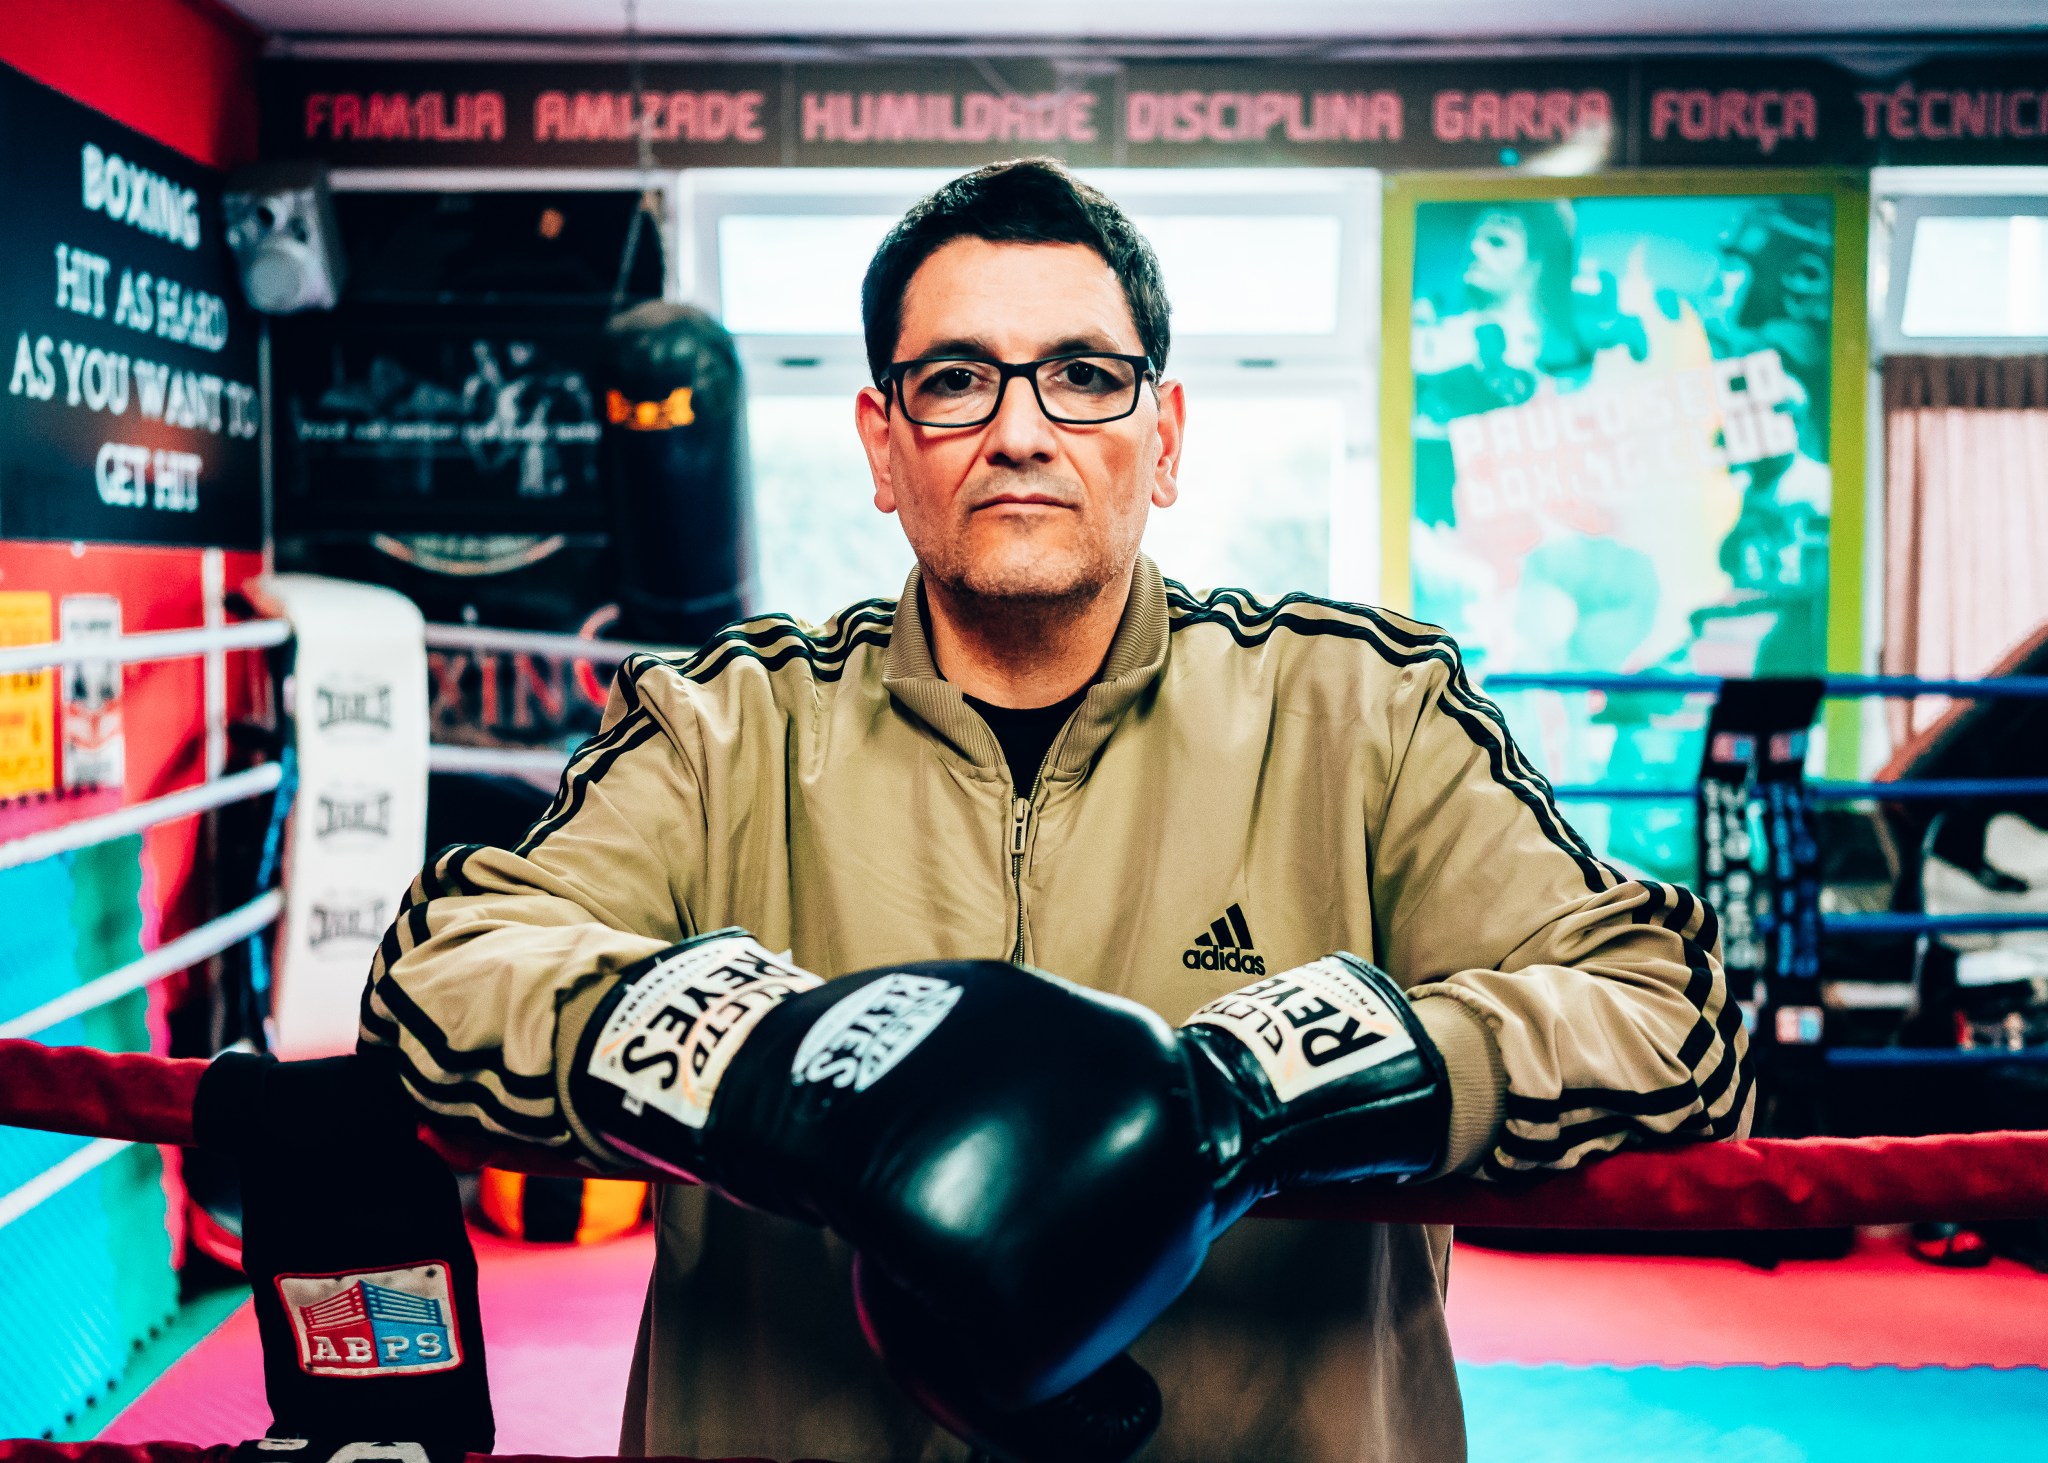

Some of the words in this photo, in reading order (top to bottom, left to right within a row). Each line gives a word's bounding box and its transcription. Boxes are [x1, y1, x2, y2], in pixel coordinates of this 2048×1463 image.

[534, 90, 765, 142] AMIZADE
[802, 91, 1097, 142] HUMILDADE
[1125, 90, 1402, 142] DISCIPLINA
[1650, 90, 1817, 155] FORÇA
[81, 141, 201, 251] BOXING
[54, 242, 111, 318] HIT
[114, 265, 154, 332] AS
[156, 277, 229, 352] HARD
[8, 330, 55, 401] AS
[59, 340, 130, 416] YOU
[133, 357, 223, 435] WANT
[95, 442, 151, 508] GET
[153, 448, 204, 513] HIT
[1182, 946, 1266, 976] adidas
[622, 950, 800, 1090] REYES
[1228, 976, 1389, 1068] REYE
[312, 1332, 443, 1364] ABPS
